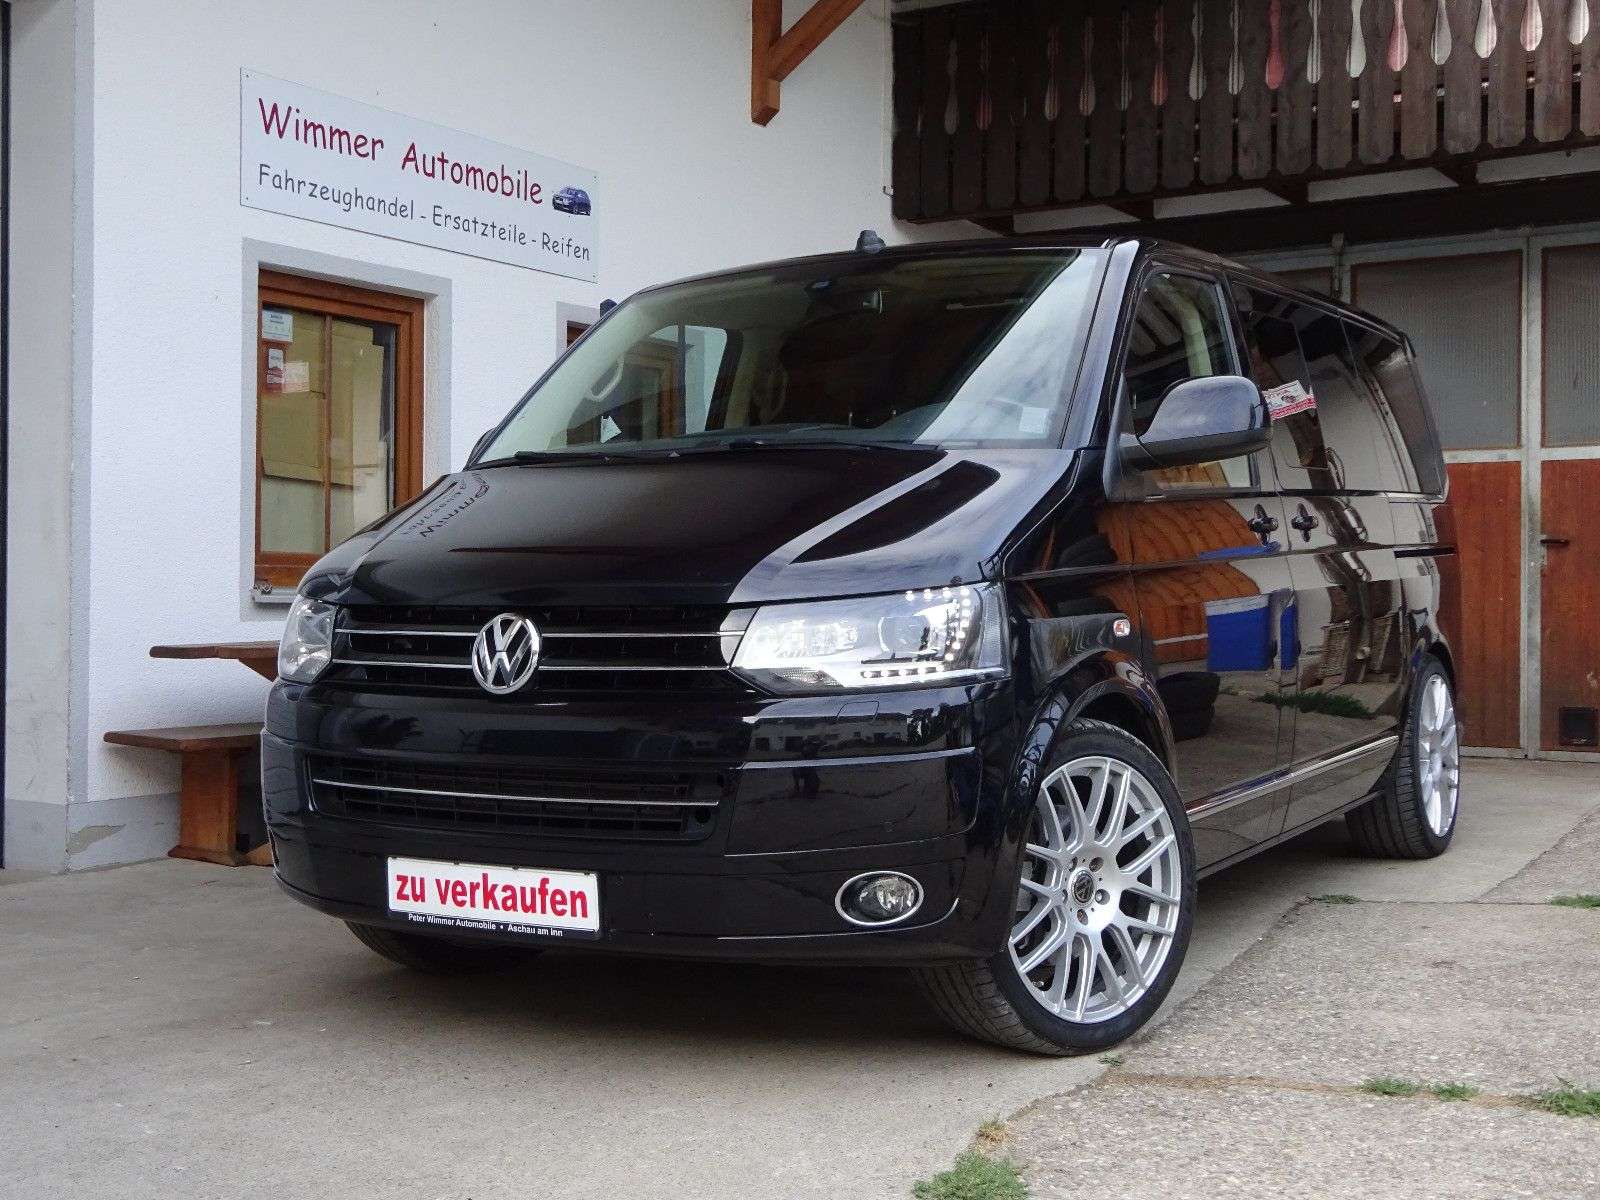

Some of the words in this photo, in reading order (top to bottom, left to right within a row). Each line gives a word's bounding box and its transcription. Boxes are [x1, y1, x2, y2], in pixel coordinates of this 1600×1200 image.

[258, 97, 384, 161] Wimmer
[401, 142, 543, 205] Automobile
[258, 163, 414, 220] Fahrzeughandel
[432, 205, 526, 246] Ersatzteile
[541, 232, 590, 261] Reifen
[474, 614, 538, 692] VW
[396, 874, 426, 903] zu
[435, 872, 588, 918] verkaufen
[408, 913, 426, 924] Peter
[426, 914, 454, 926] Wimmer
[456, 918, 496, 930] Automobile
[508, 924, 536, 935] Aschau
[537, 928, 549, 936] am
[550, 928, 563, 937] Inn
